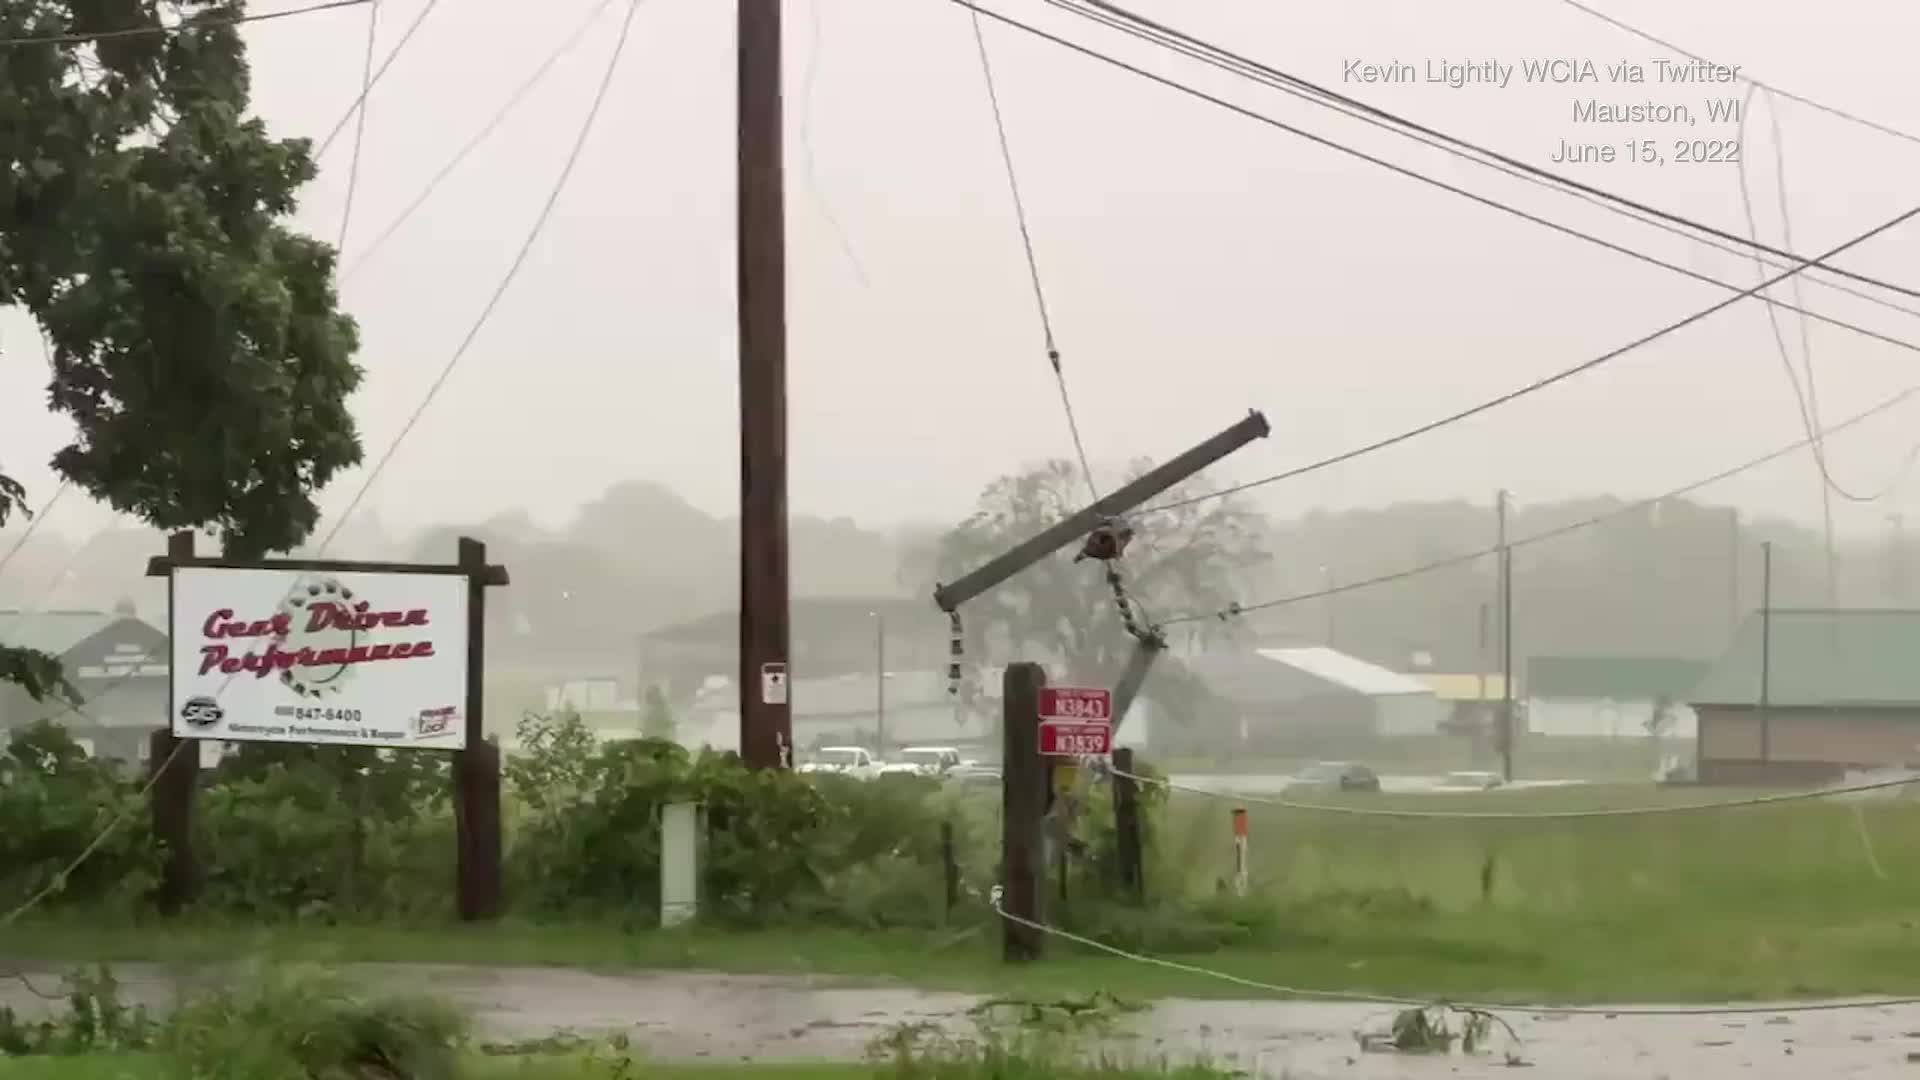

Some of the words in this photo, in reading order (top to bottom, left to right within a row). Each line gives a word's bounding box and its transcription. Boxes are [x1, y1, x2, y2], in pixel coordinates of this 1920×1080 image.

[203, 609, 293, 639] Gear
[304, 600, 430, 633] Driven
[198, 641, 435, 678] Performance
